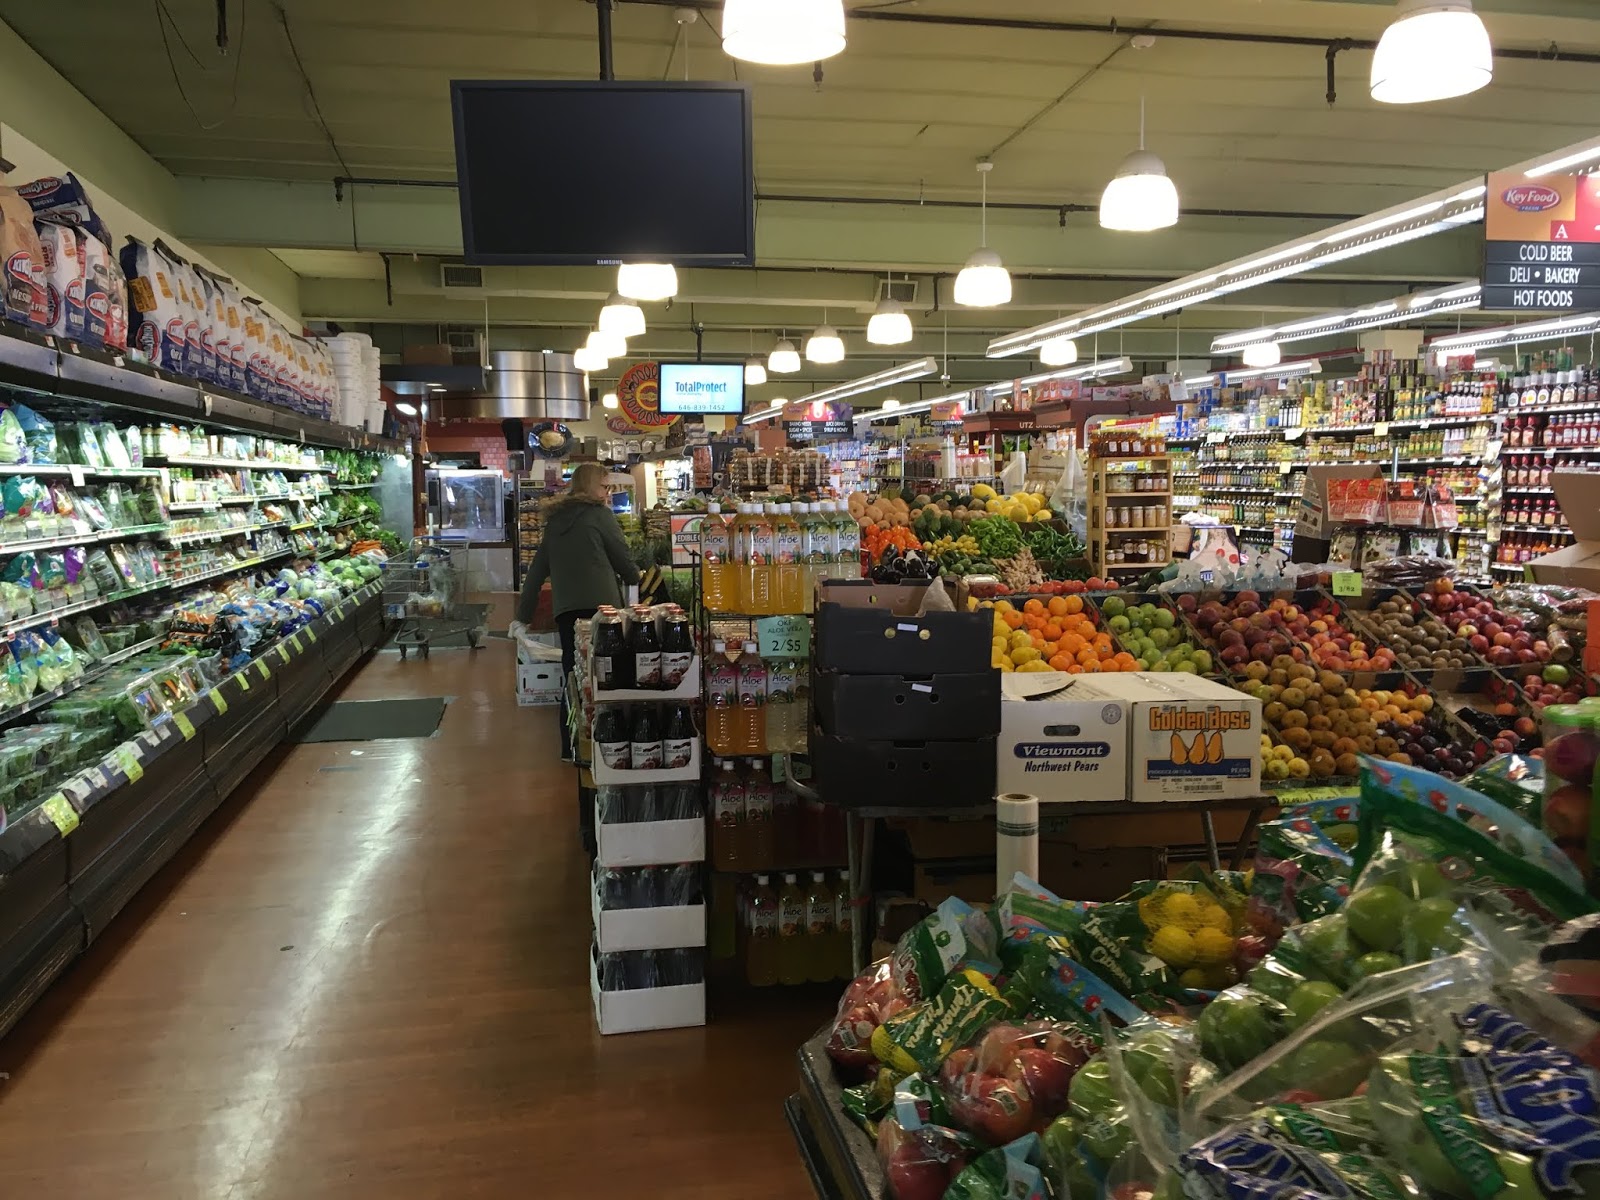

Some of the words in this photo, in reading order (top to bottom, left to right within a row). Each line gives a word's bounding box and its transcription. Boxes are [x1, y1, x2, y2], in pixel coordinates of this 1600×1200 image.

[1506, 189, 1528, 204] Key
[1528, 191, 1555, 203] Food
[1555, 224, 1569, 239] A
[1519, 244, 1548, 261] COLD
[1550, 245, 1573, 261] BEER
[1509, 266, 1531, 283] DELI
[1544, 267, 1581, 284] BAKERY
[1513, 290, 1535, 306] HOT
[1537, 290, 1573, 307] FOODS
[675, 381, 727, 393] TotalProtect
[1019, 421, 1034, 429] UTZ
[677, 534, 697, 542] EDIBLE
[704, 535, 725, 544] Aloe
[778, 534, 799, 544] Aloe
[810, 533, 830, 542] Aloe
[839, 532, 858, 541] Aloe
[771, 638, 801, 652] 2/$5
[710, 675, 732, 685] Aloe
[741, 676, 762, 685] Aloe
[772, 673, 793, 682] Aloe
[1149, 705, 1207, 732] Golden
[1022, 744, 1104, 757] Viewmont
[1024, 760, 1071, 773] Northwest
[1073, 760, 1100, 772] Pears
[720, 794, 741, 803] Aloe
[749, 793, 769, 801] Aloe
[756, 910, 774, 918] Aloe
[783, 907, 802, 916] Aloe
[811, 906, 830, 914] Aloe
